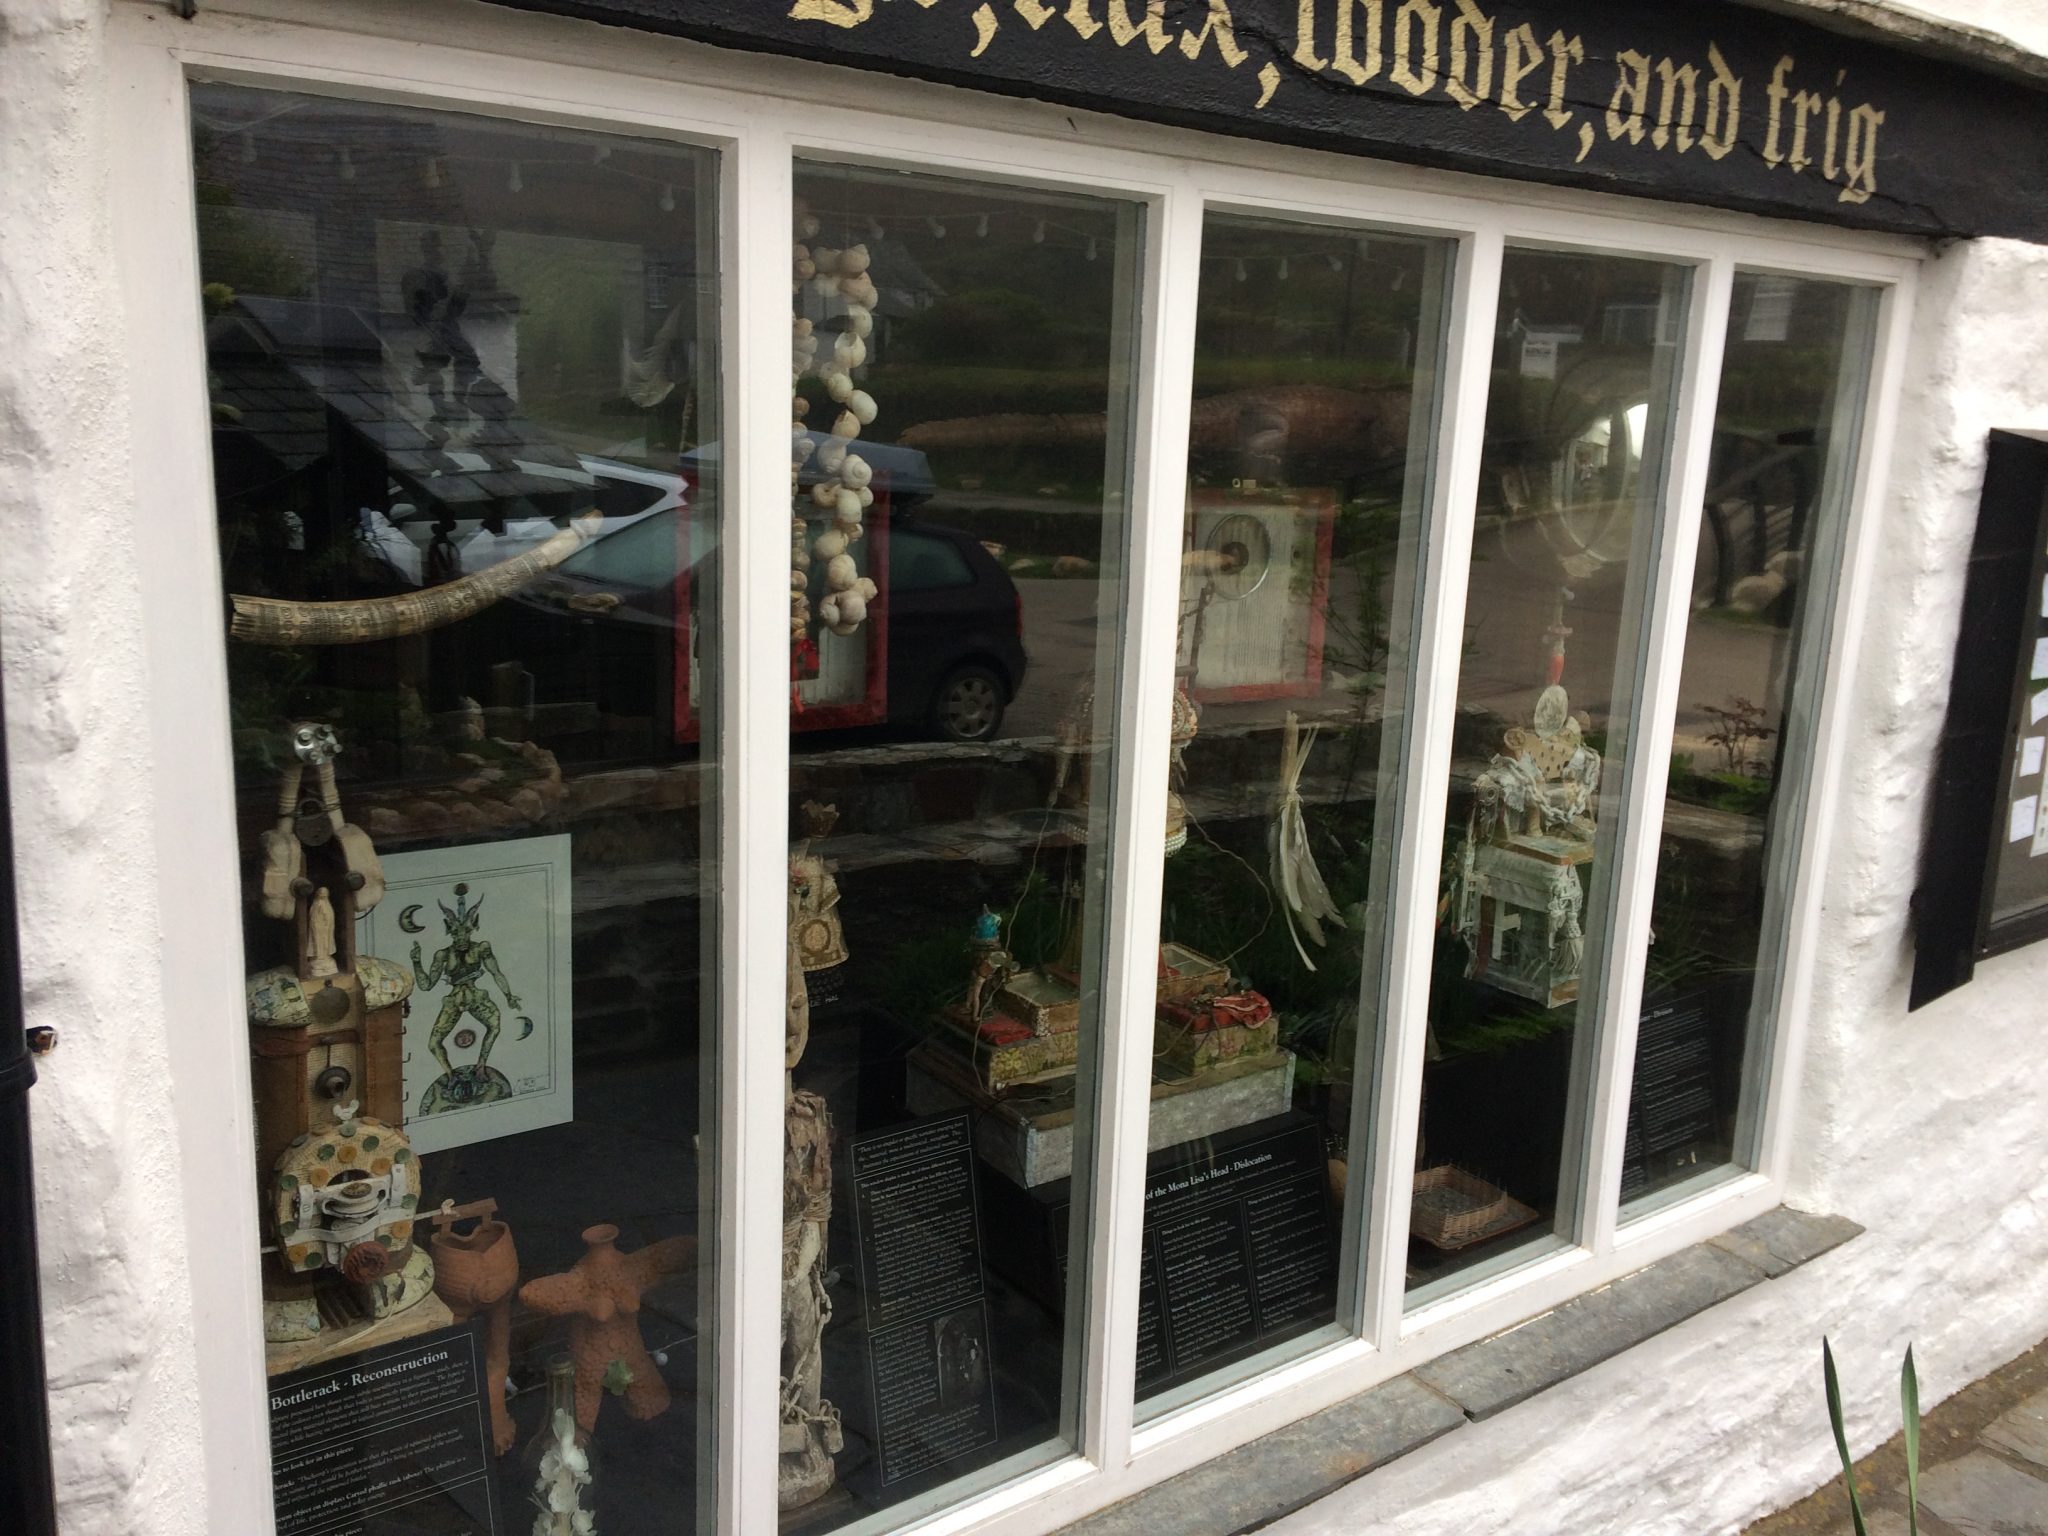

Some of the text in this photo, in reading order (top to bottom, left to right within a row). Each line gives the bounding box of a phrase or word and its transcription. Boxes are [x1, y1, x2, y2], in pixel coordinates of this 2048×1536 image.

[1606, 40, 1743, 161] and
[1765, 55, 1886, 204] frig
[1145, 1189, 1154, 1200] of
[1154, 1187, 1167, 1198] the
[1168, 1180, 1189, 1193] Mona
[1189, 1172, 1210, 1186] Lisa's
[1209, 1165, 1230, 1179] Head
[1233, 1153, 1272, 1171] Dislocation
[271, 1380, 340, 1411] Bottlerack
[350, 1351, 449, 1387] Reconstruction
